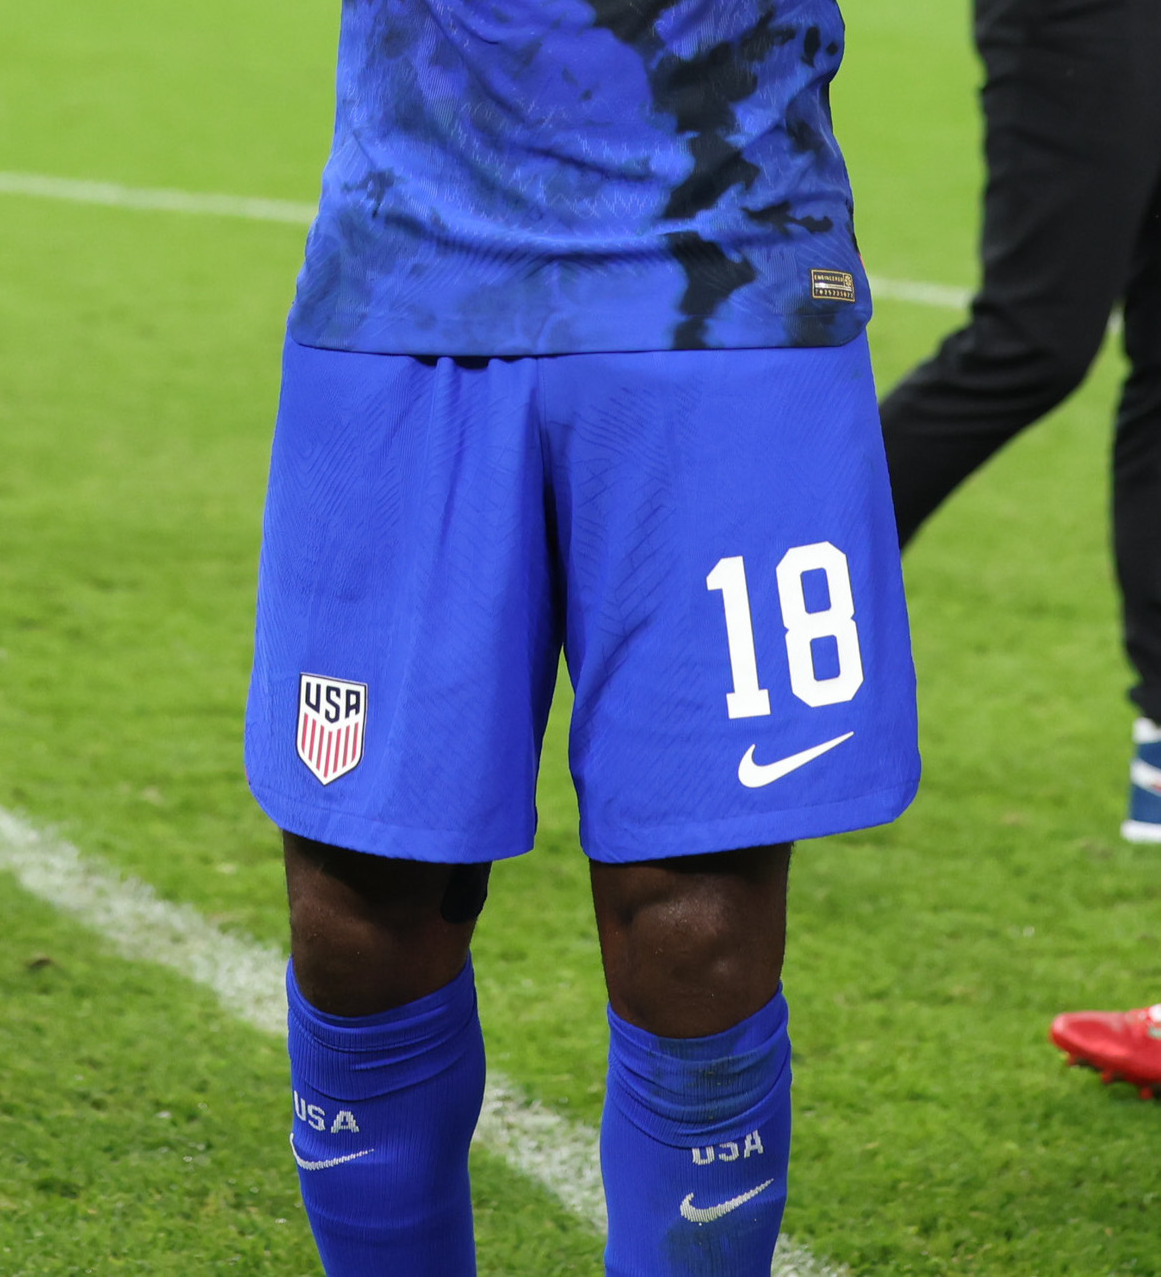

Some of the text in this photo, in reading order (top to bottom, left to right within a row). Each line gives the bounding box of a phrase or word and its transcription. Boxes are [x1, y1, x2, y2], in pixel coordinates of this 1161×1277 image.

[705, 540, 865, 720] 18
[304, 681, 361, 724] USA
[293, 1090, 360, 1134] USA
